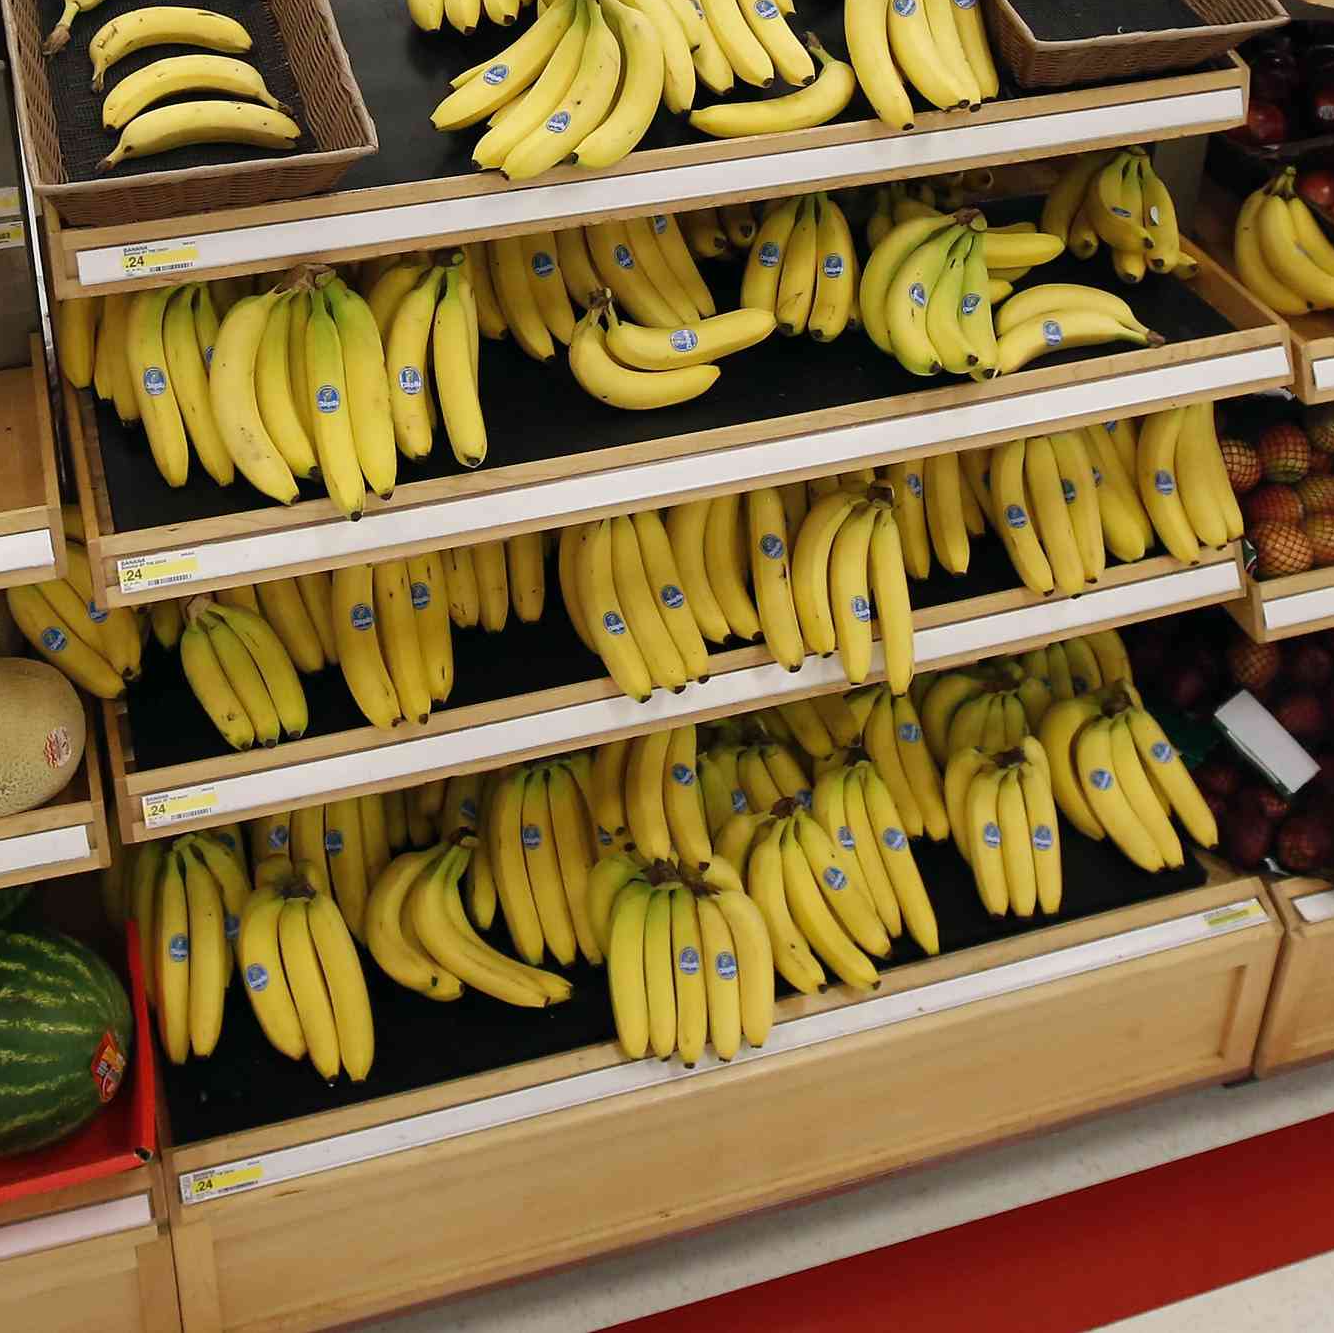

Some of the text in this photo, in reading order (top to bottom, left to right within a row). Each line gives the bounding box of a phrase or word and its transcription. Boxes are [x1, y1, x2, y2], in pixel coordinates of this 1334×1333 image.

[125, 256, 144, 268] .24
[123, 568, 143, 583] .24
[147, 804, 166, 817] .24
[195, 1179, 214, 1193] .24
